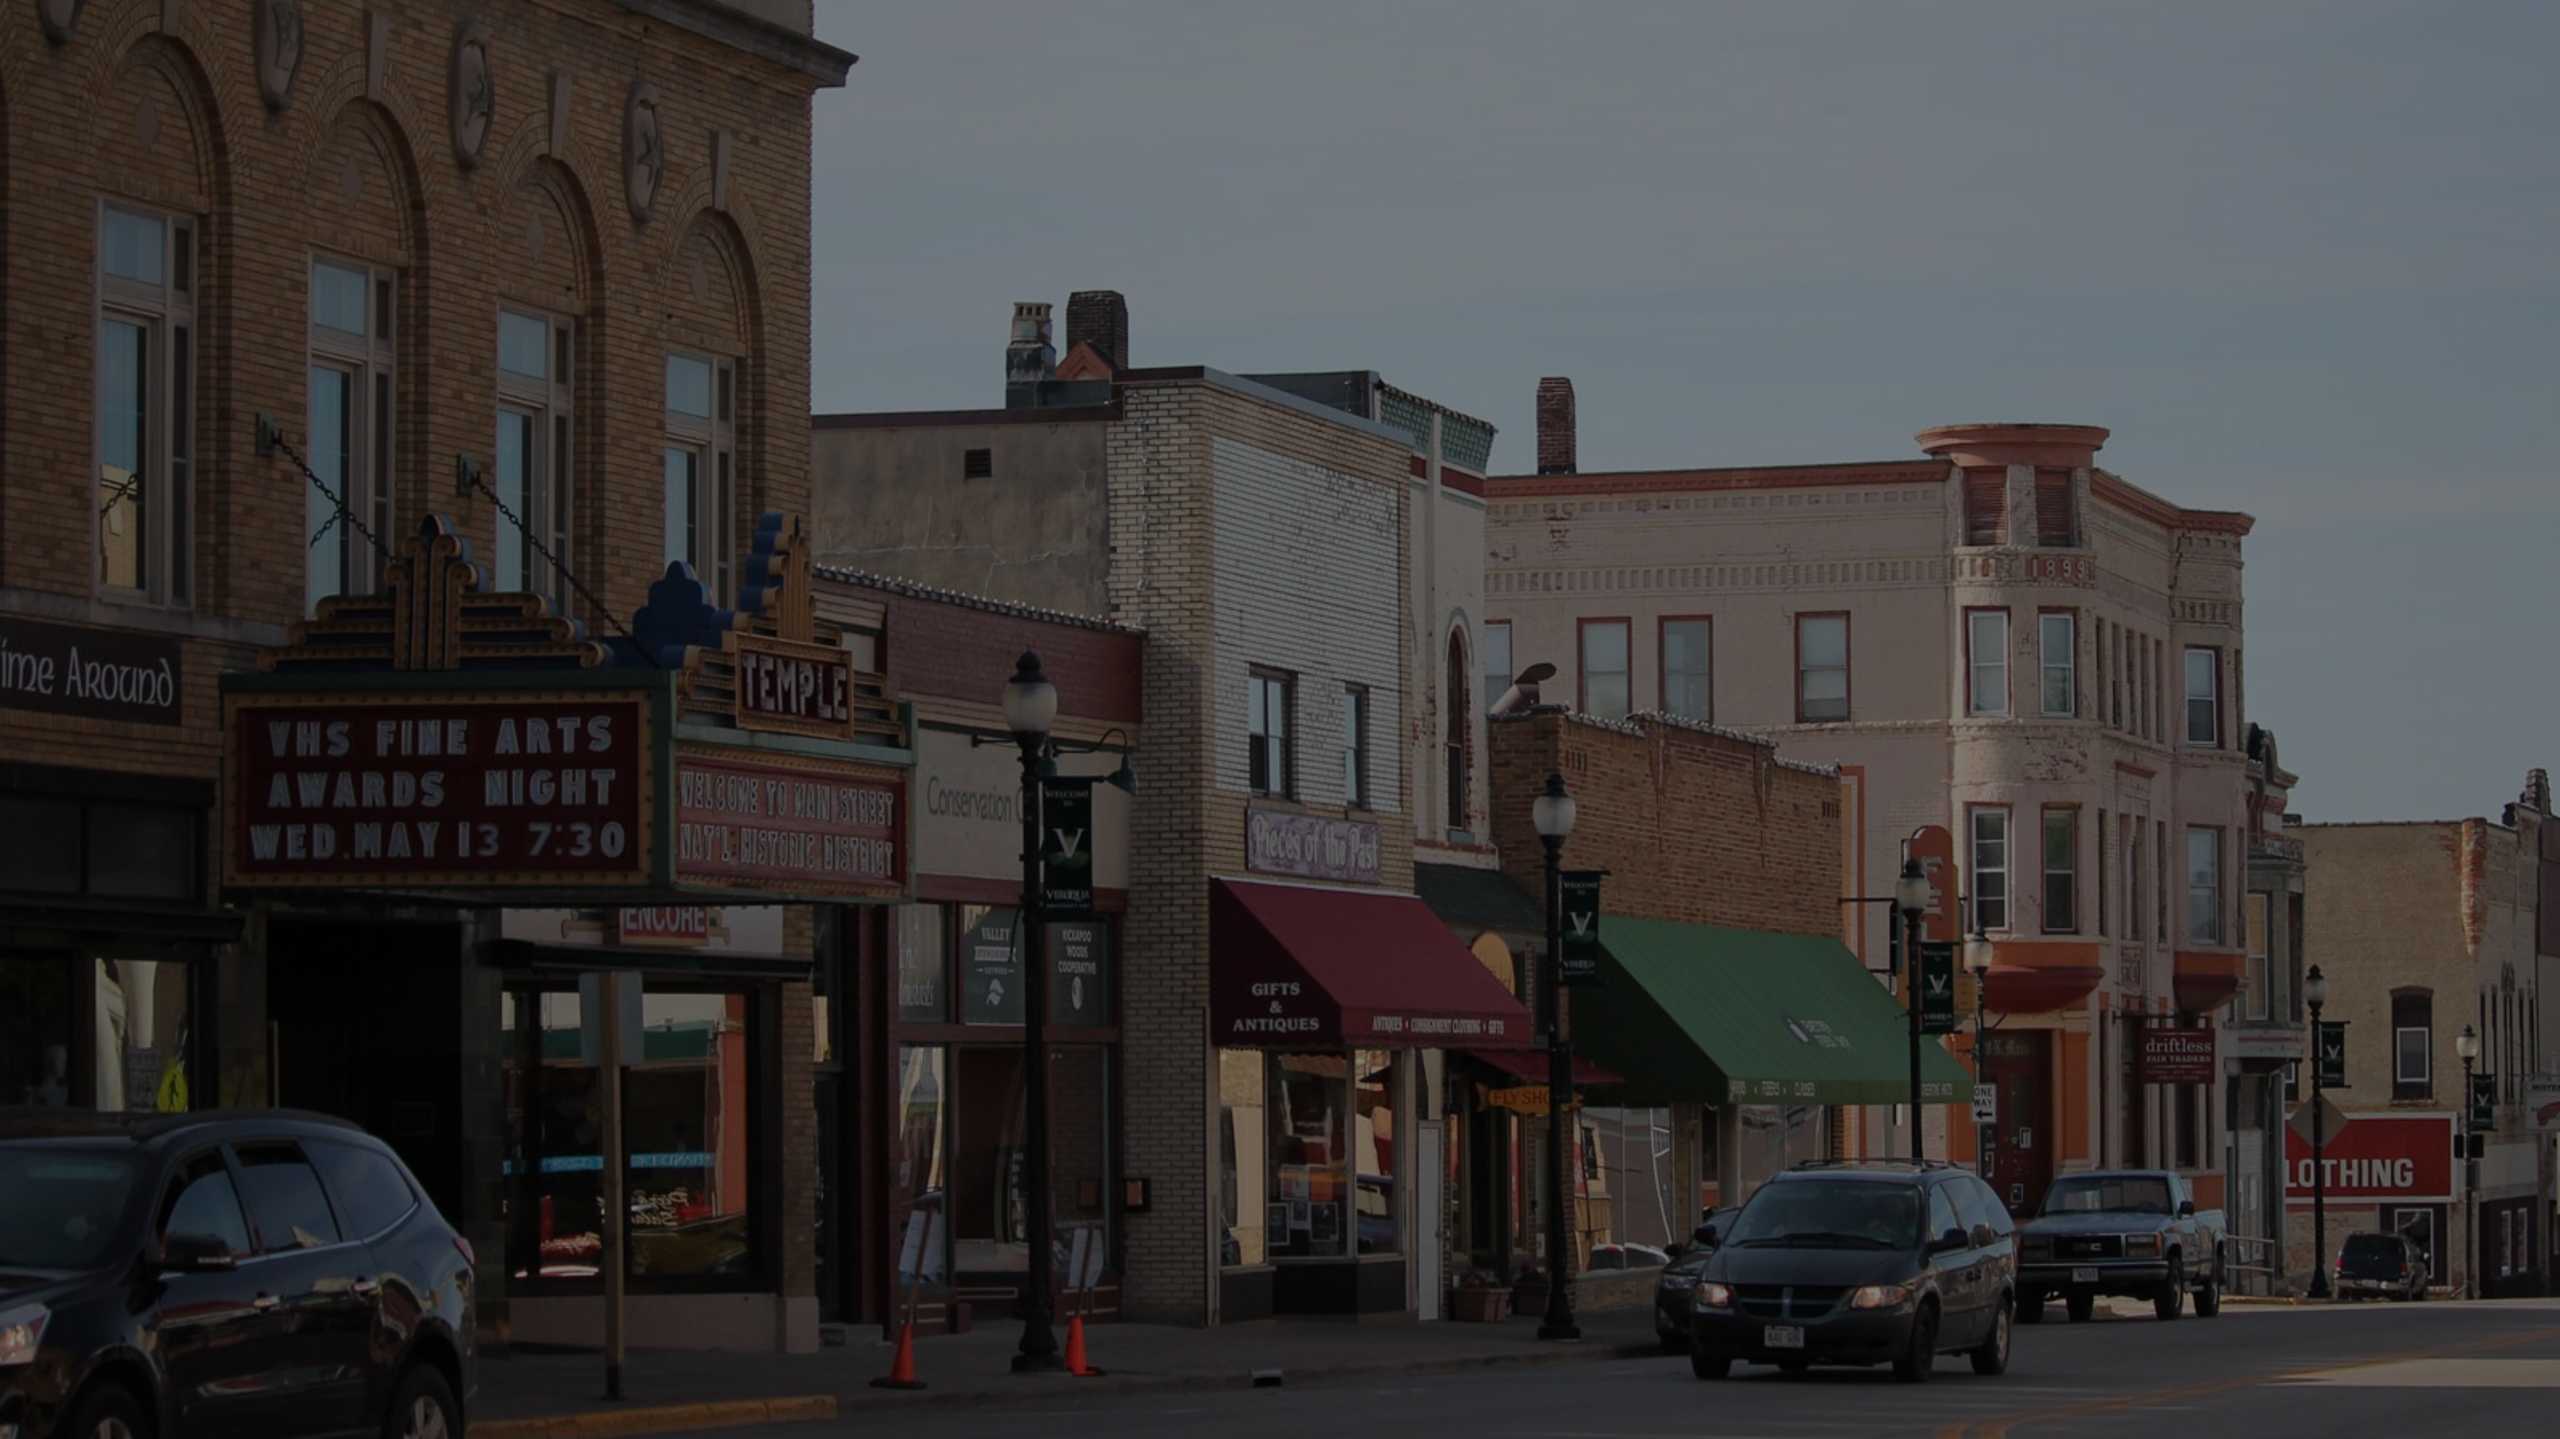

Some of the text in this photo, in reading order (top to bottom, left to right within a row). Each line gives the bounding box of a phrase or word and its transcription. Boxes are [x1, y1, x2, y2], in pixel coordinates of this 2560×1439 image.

[65, 645, 174, 708] Around
[742, 652, 848, 722] TEMPLE
[267, 715, 613, 758] VHS FINE ARTS
[267, 767, 618, 809] AWARDS NIGHT
[680, 770, 894, 827] WELCOME TO MAIN STREET
[927, 776, 1012, 823] Conservation
[456, 820, 500, 858] 13
[527, 821, 626, 859] 7:30
[740, 827, 816, 870] HISTORIC
[823, 834, 894, 877] DISTRICT
[1051, 827, 1087, 859] V
[1250, 814, 1378, 877] Pieces of the Past
[624, 905, 706, 933] ENCORE
[1568, 911, 1593, 936] V
[1250, 981, 1302, 997] GIFTS
[1927, 973, 1948, 995] V
[1268, 999, 1283, 1014] &
[1231, 1017, 1321, 1034] ANTIQUES
[2145, 1036, 2213, 1053] driftless
[1973, 1098, 1993, 1109] WAY
[1974, 1086, 1993, 1098] ONE
